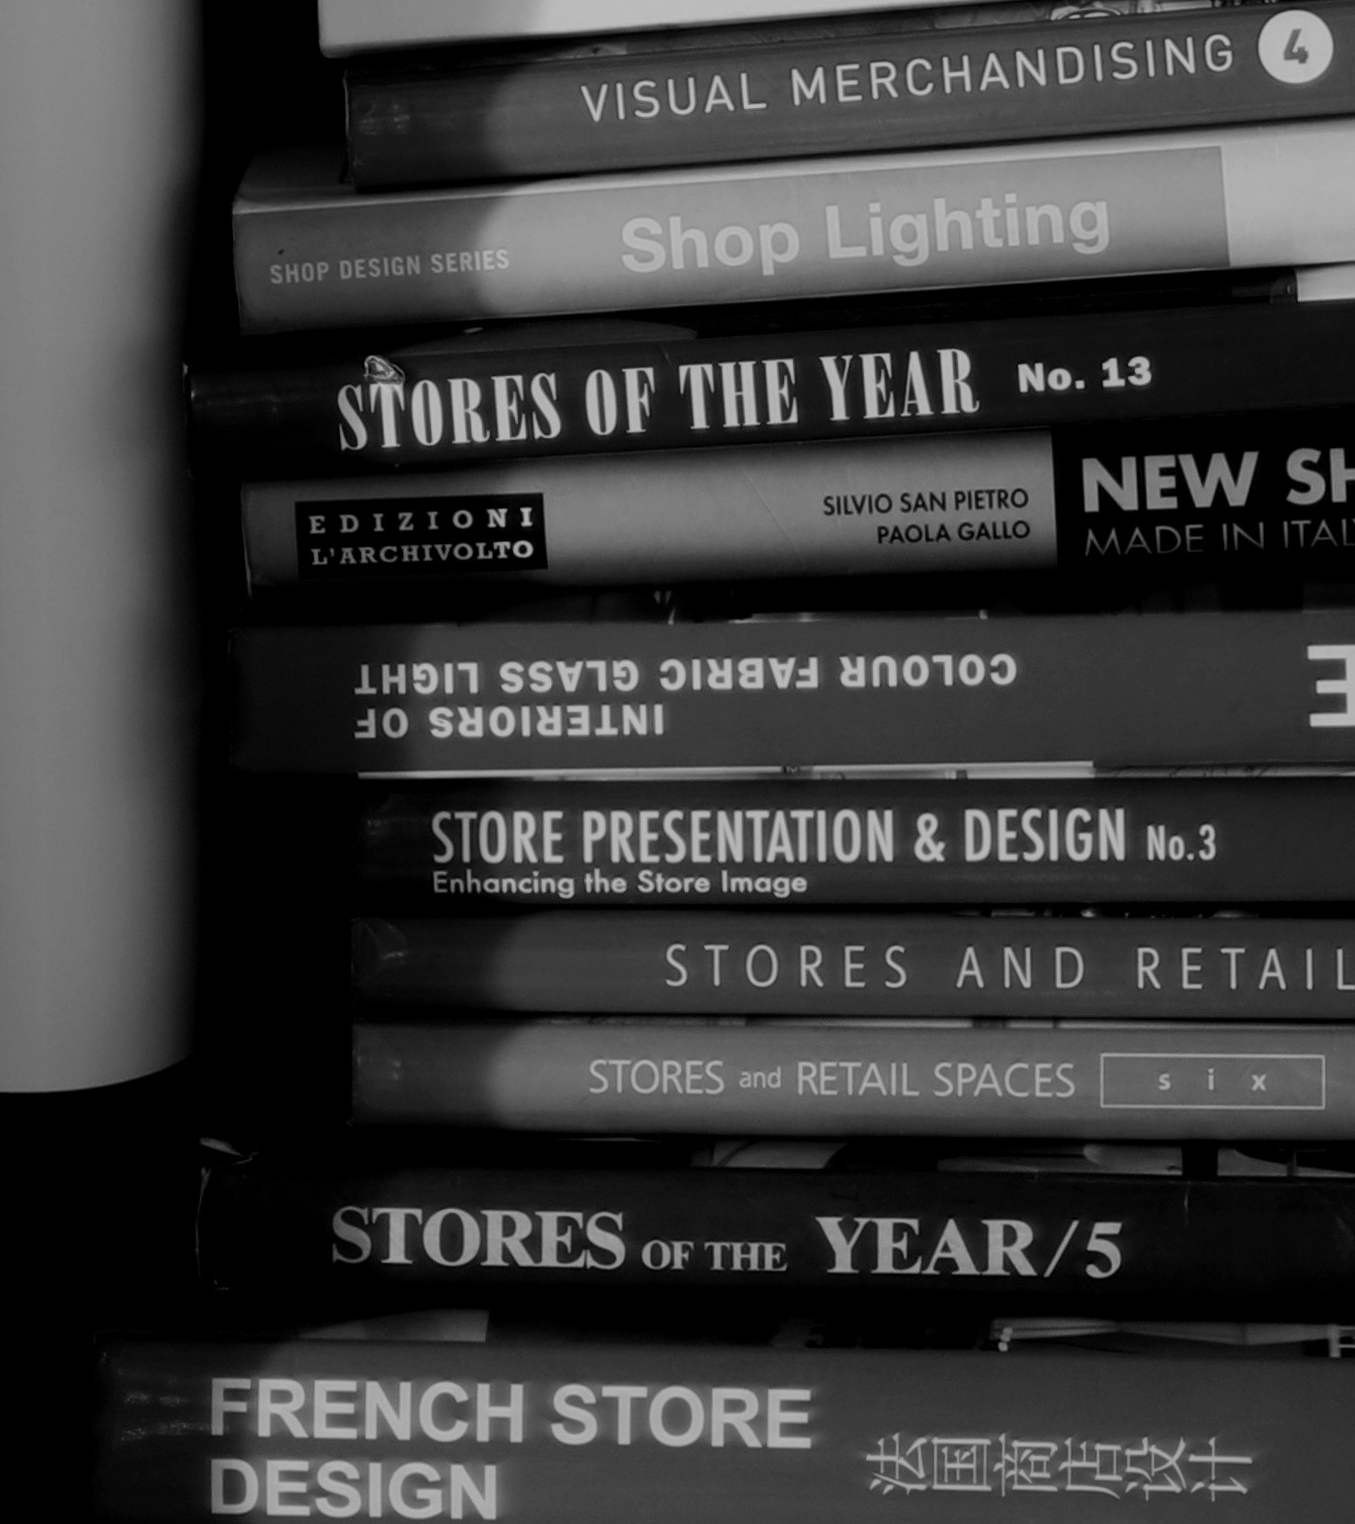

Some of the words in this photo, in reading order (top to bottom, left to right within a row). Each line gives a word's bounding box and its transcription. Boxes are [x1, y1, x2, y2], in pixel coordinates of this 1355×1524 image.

[581, 71, 767, 124] VISUAL
[792, 32, 1234, 107] MERCHANDISING
[620, 214, 801, 276] Shop
[825, 193, 1111, 267] Lighting
[269, 261, 330, 285] SHOP
[339, 255, 421, 279] DESIGN
[430, 248, 510, 274] SERIES
[337, 372, 562, 451] STORES
[585, 366, 656, 436] OF
[678, 358, 800, 430] THE
[818, 347, 980, 421] YEAR
[1018, 361, 1085, 393] No.
[1101, 356, 1153, 390] 13
[1081, 450, 1259, 513] NEW
[822, 492, 893, 516] SILVIO
[899, 490, 948, 514] SAN
[952, 488, 1029, 512] PIETRO
[308, 506, 533, 535] EDIZIONI
[877, 522, 951, 545] PAOLA
[957, 520, 1031, 543] GALLO
[312, 540, 534, 566] L'ARCHIVOLTO
[1085, 524, 1204, 557] MADE
[1222, 521, 1265, 550] IN
[354, 661, 479, 695] LIGHT
[500, 659, 639, 694] GLASS
[659, 656, 820, 691] FABRIC
[839, 652, 1018, 688] COLOUR
[355, 707, 409, 740] OF
[429, 703, 666, 739] INTERIORS
[432, 810, 564, 865] STORE
[582, 809, 894, 865] PRESENTATION
[914, 812, 946, 864] &
[964, 807, 1127, 863] DESIGN
[432, 871, 575, 899] Enhancing
[584, 869, 630, 895] the
[636, 869, 711, 895] Store
[720, 869, 808, 899] Image
[664, 944, 909, 990] STORES
[955, 945, 1085, 990] AND
[583, 1058, 725, 1095] STORES
[739, 1065, 782, 1090] and
[797, 1060, 920, 1097] RETAIL
[933, 1062, 1076, 1099] SPACES
[1157, 1069, 1268, 1093] six
[331, 1206, 627, 1271] STORES
[641, 1239, 695, 1272] OF
[704, 1240, 788, 1273] THE
[815, 1215, 1124, 1280] YEAR/5
[210, 1376, 524, 1444] FRENCH
[550, 1383, 813, 1449] STORE
[865, 1432, 1254, 1503] 法国商店设计
[210, 1457, 498, 1521] DESIGN
